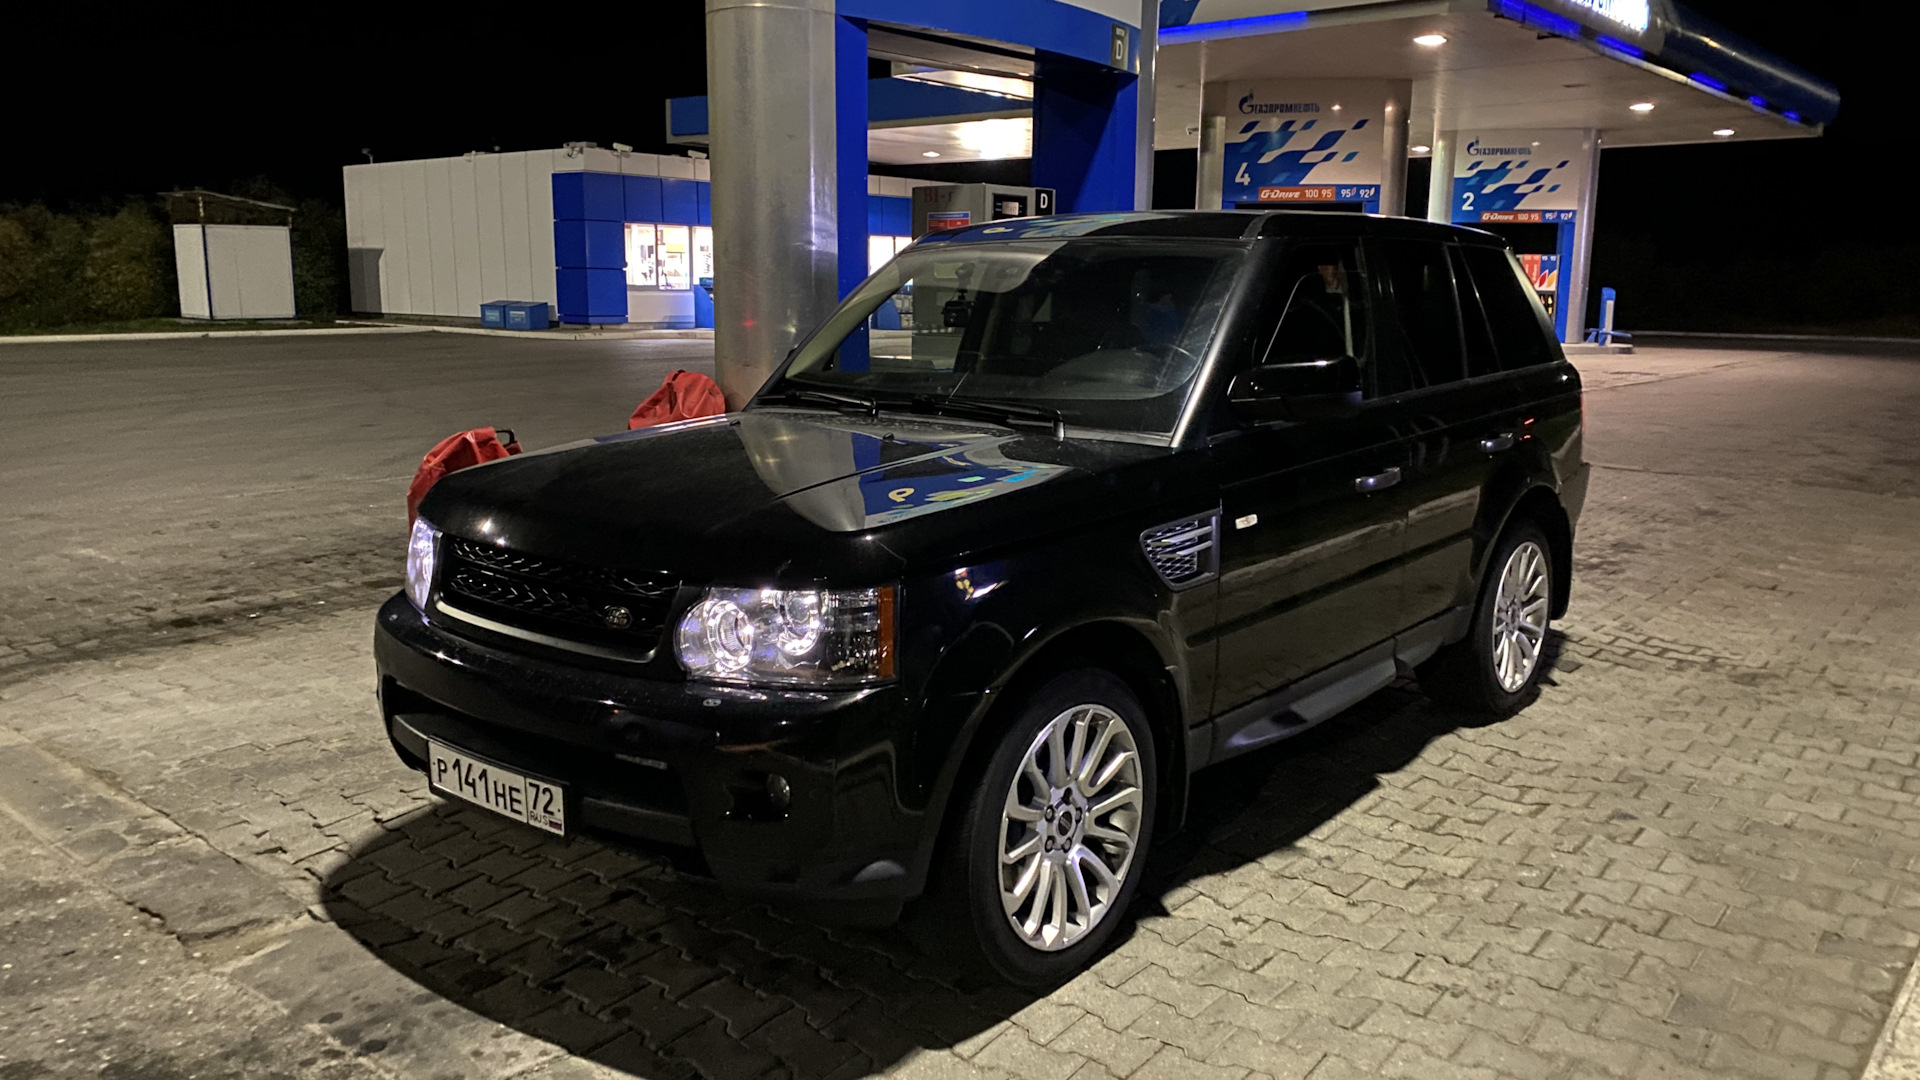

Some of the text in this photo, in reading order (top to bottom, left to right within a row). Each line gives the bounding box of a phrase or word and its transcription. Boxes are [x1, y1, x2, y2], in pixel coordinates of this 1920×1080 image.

[1234, 162, 1251, 186] 4
[1305, 189, 1319, 198] 100
[1321, 189, 1332, 198] 95
[1341, 188, 1370, 198] 95 92
[1040, 193, 1049, 209] D
[1461, 192, 1475, 211] 2
[1517, 212, 1529, 220] 100
[528, 781, 554, 816] 72
[530, 811, 549, 826] RUS
